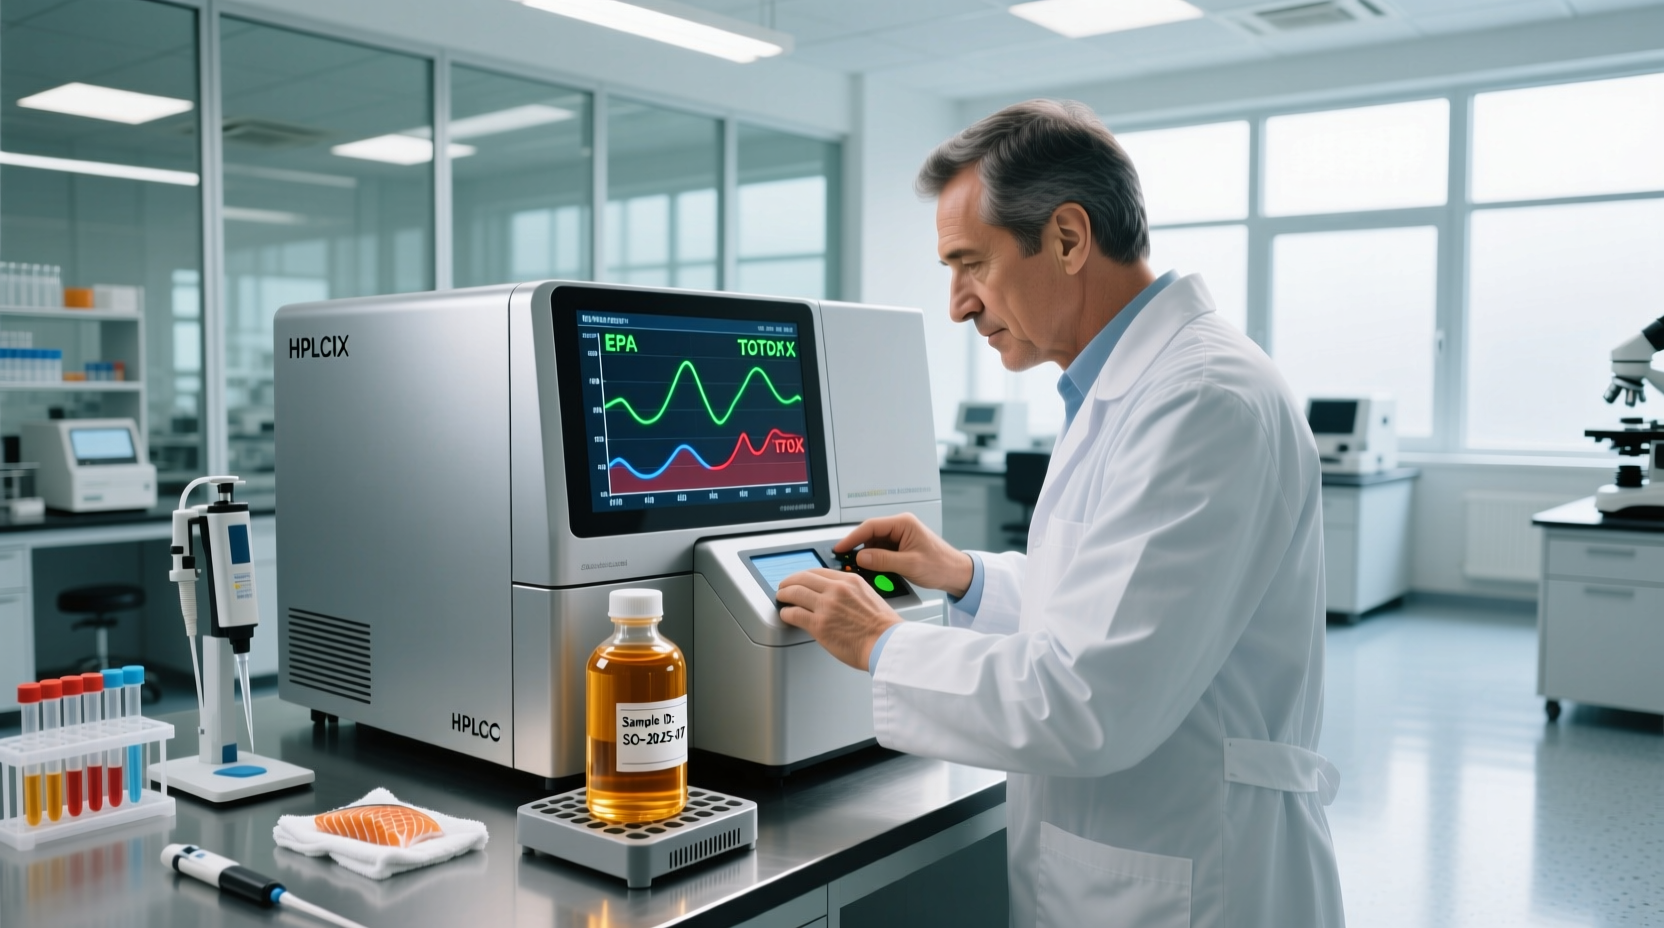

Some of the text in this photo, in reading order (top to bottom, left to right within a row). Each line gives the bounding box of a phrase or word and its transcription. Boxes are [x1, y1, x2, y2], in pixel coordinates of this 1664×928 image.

[289, 334, 349, 359] HPLCIX
[605, 333, 638, 353] EPA
[622, 713, 675, 728] Sample ID:
